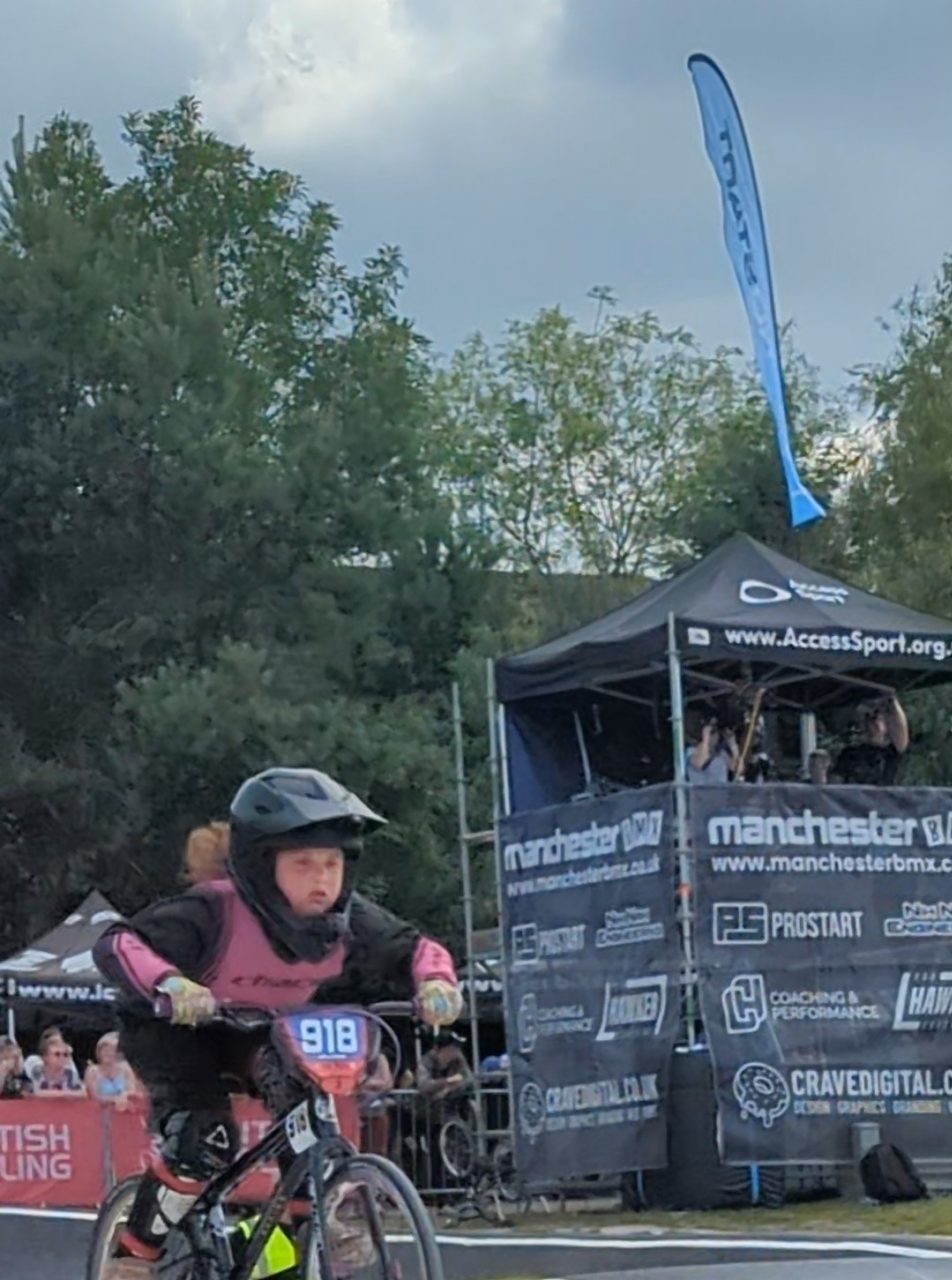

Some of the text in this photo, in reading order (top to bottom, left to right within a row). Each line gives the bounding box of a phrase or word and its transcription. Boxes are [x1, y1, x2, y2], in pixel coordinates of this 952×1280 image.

[707, 808, 918, 846] manchester
[504, 821, 620, 871] manchester
[772, 910, 863, 938] PROSTART
[770, 991, 845, 1005] COACHING
[772, 1005, 881, 1020] PERFORMANCE
[300, 1018, 358, 1053] 918
